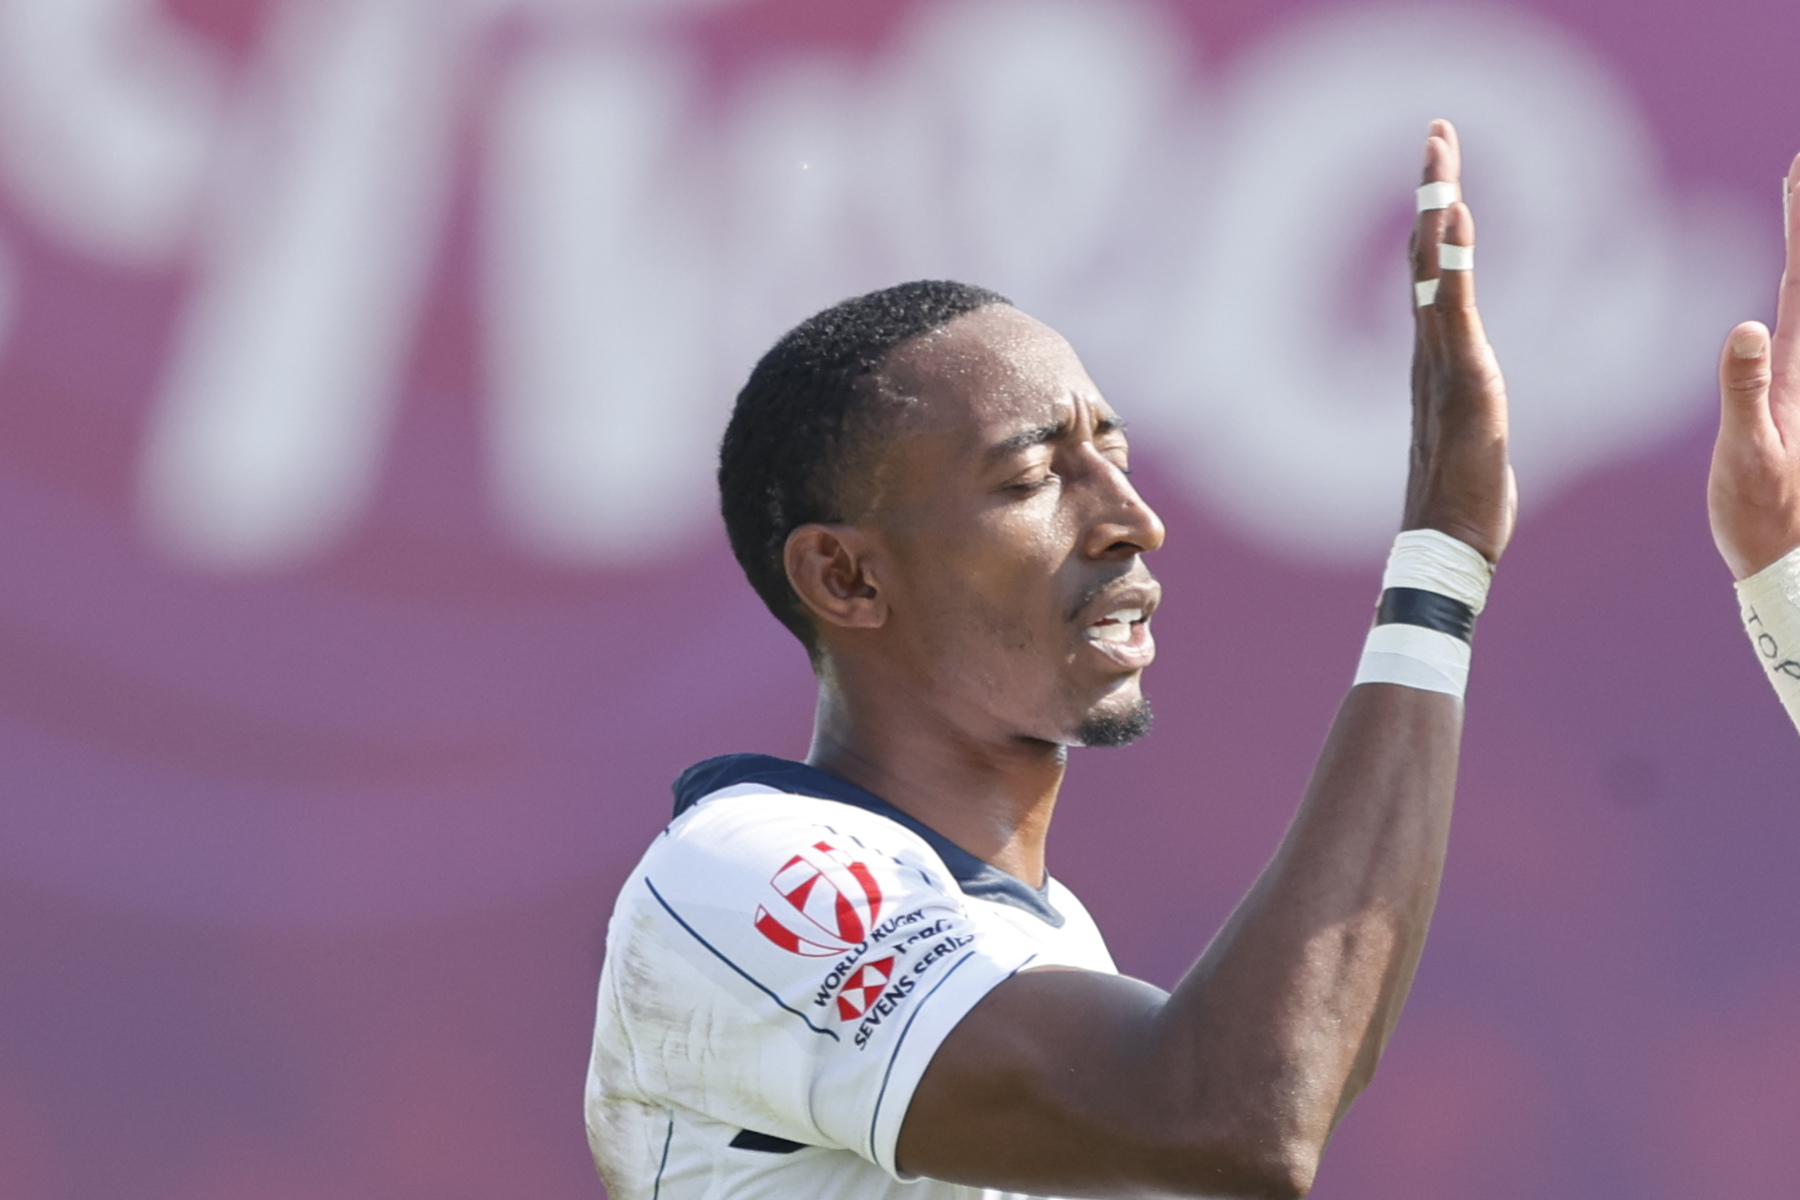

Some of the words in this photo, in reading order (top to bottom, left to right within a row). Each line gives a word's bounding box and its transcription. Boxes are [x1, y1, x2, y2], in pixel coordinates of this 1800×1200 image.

[813, 940, 870, 1008] WORLD
[870, 908, 926, 943] RUGBY
[854, 975, 916, 1052] SEVENS
